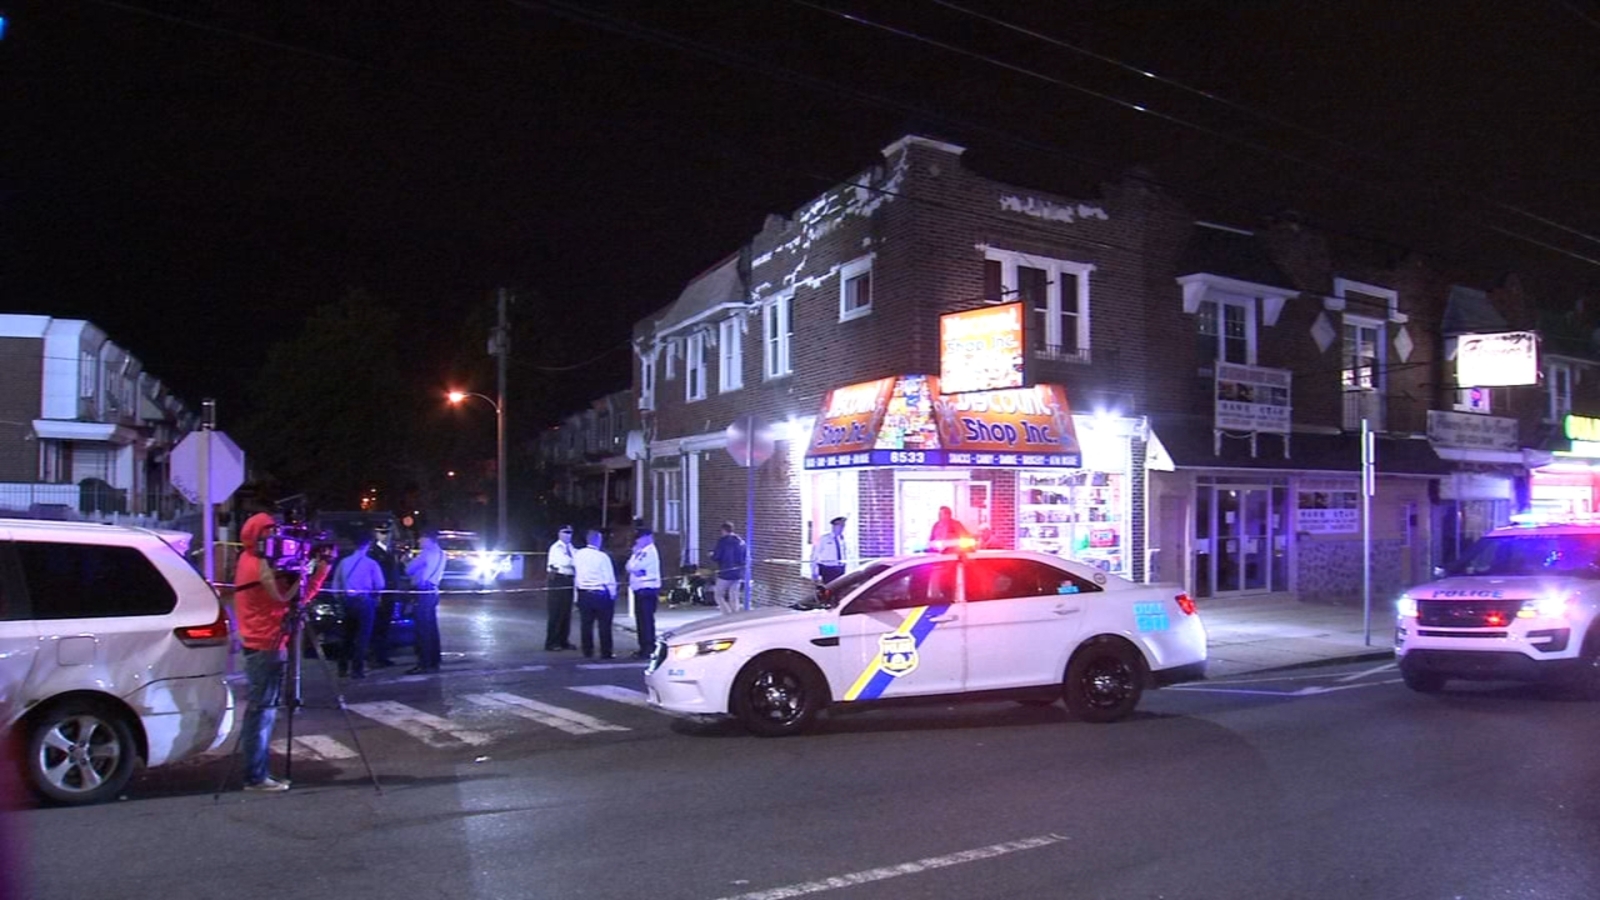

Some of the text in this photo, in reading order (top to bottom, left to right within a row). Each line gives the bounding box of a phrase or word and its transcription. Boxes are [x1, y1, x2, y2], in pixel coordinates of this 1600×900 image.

[961, 418, 1059, 447] Shop Inc.
[890, 451, 925, 463] 6533
[1432, 589, 1504, 598] POLICE
